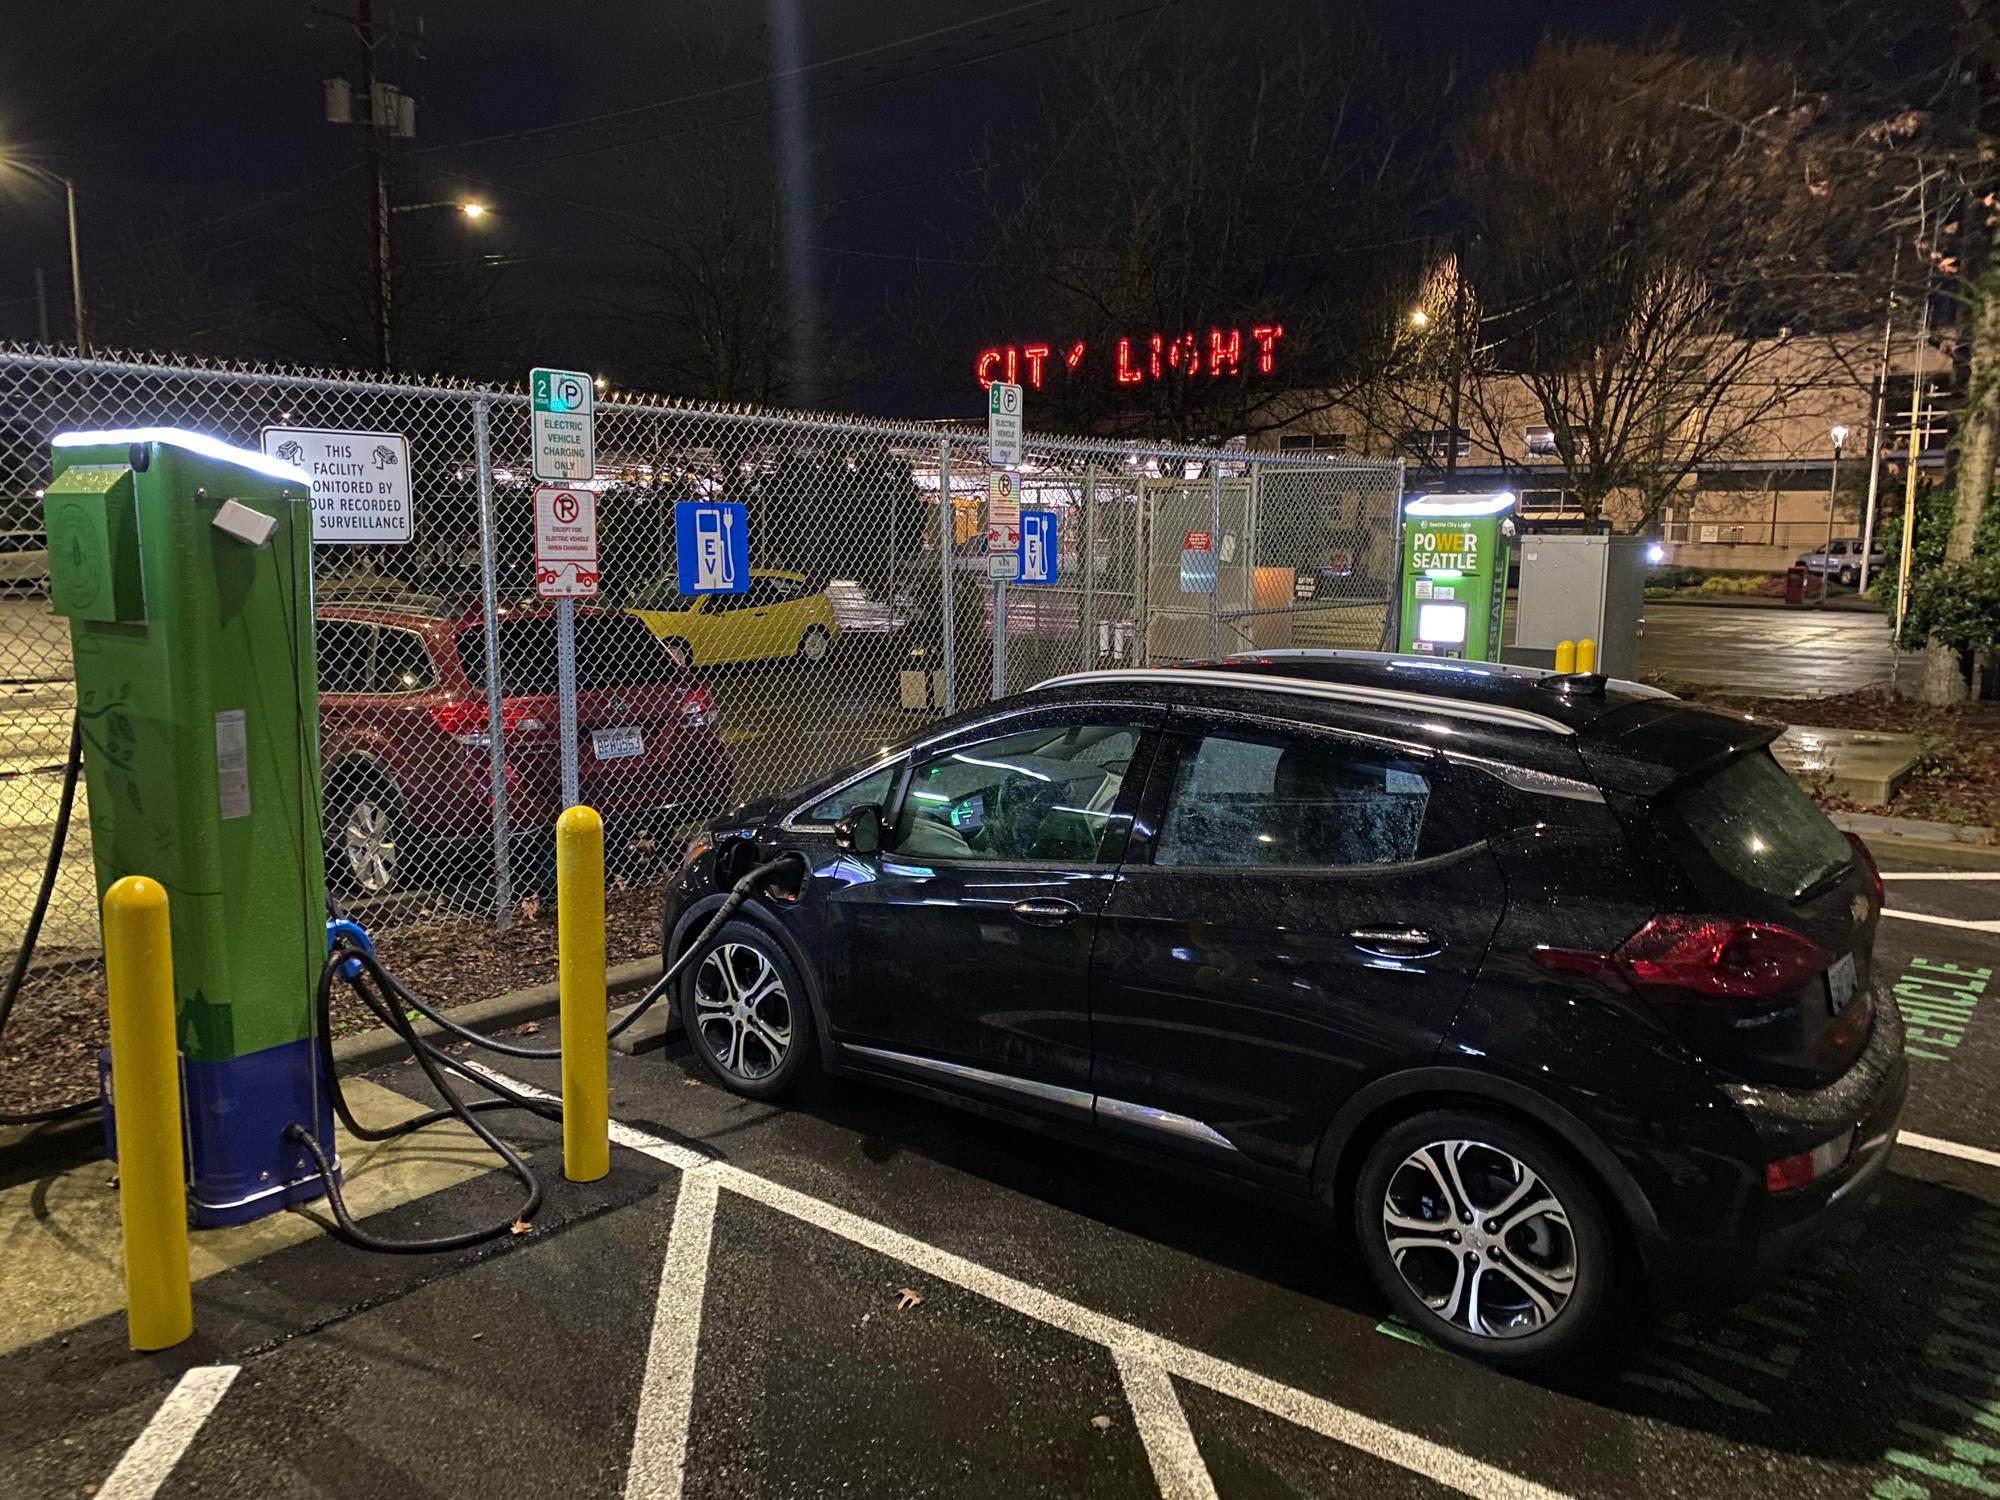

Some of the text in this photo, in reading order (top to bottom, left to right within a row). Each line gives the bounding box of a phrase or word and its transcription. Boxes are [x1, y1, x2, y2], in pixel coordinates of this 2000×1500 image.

[1119, 325, 1282, 382] LIGHT
[538, 380, 546, 397] 2
[993, 390, 998, 404] 2
[544, 420, 582, 431] ELECTRIC
[547, 433, 581, 444] VEHICLE
[325, 445, 352, 458] THIS
[543, 447, 585, 458] CHARGING
[314, 462, 364, 475] FACILITY
[554, 461, 575, 470] ONLY
[313, 480, 393, 494] ONITORED BY
[311, 498, 401, 512] OUR RECORDED
[320, 516, 405, 529] SURVEILLANCE
[1447, 521, 1457, 529] City
[1457, 521, 1472, 529] Light
[1413, 533, 1478, 552] POWER
[1412, 552, 1478, 569] SEATTLE
